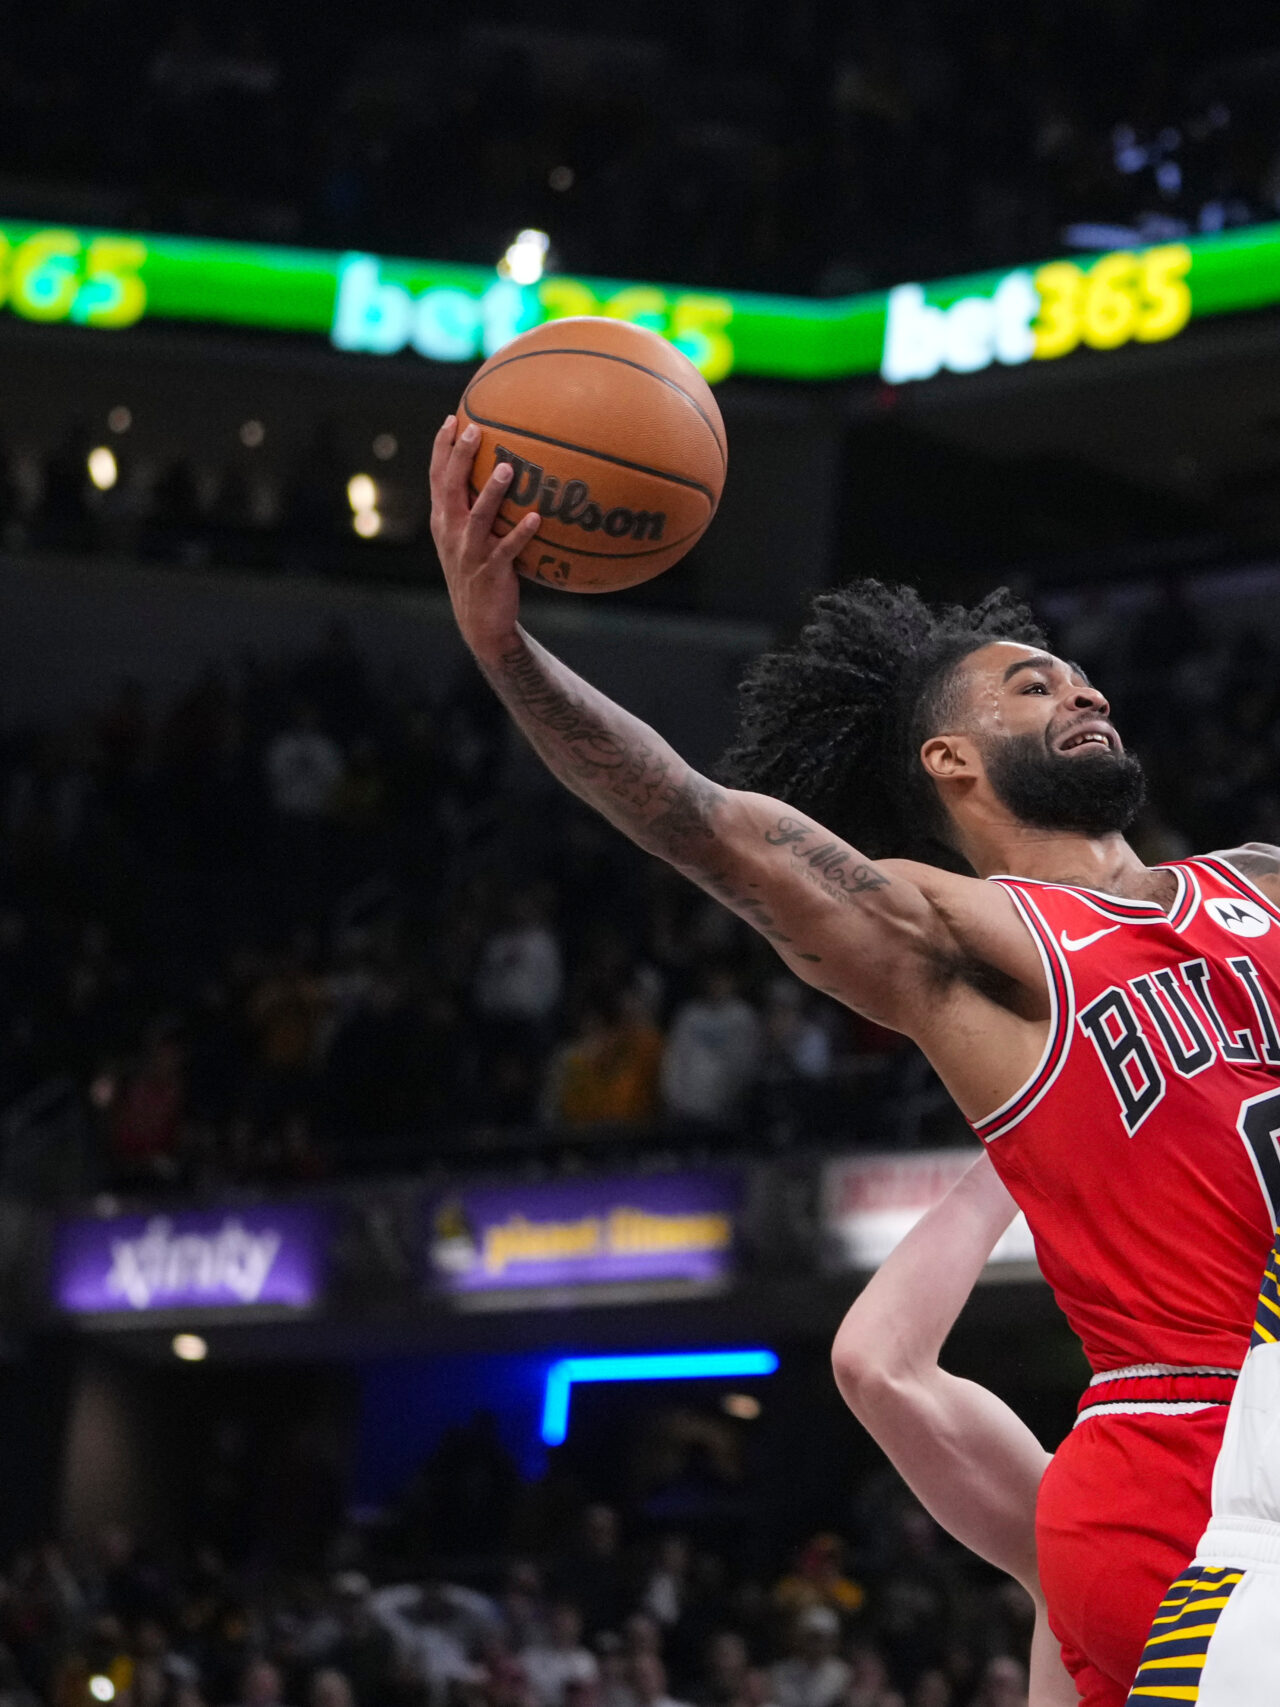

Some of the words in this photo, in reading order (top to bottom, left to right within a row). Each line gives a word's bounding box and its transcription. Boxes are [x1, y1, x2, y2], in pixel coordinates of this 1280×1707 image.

[0, 228, 149, 330] 65
[881, 244, 1193, 384] bet365
[494, 445, 667, 541] Wilson
